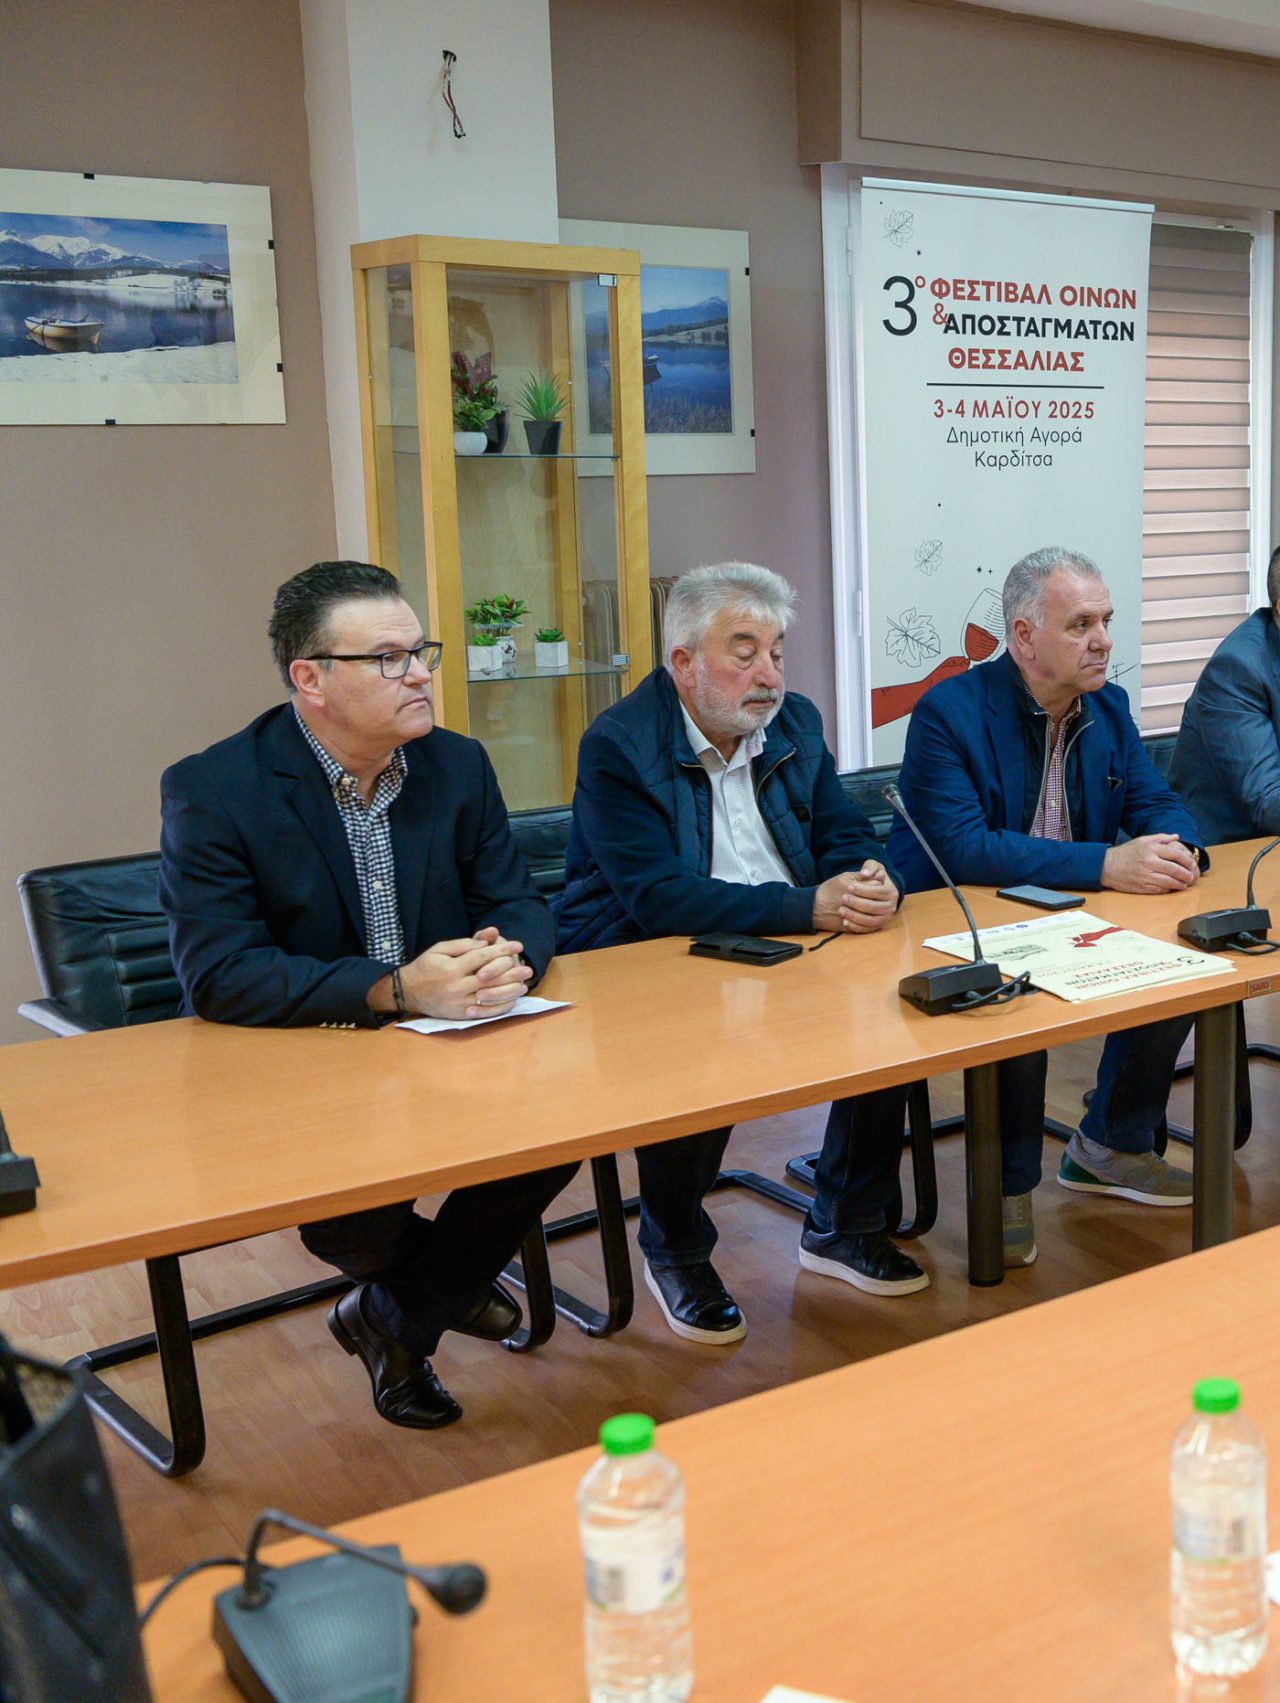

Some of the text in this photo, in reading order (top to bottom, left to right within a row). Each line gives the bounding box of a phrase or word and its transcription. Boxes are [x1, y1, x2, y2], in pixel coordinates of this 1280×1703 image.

[930, 277, 1052, 305] ΦΕΣΤΙΒΑΛ
[1059, 285, 1137, 310] ΟΙΝΩΝ
[943, 313, 1135, 341] ΑΠΟΣΤΑΓΜΑΤΩΝ
[948, 347, 1085, 372] ΘΕΣΣΑΛΙΑΣ
[933, 396, 1095, 419] 3-4 ΜΑΪΟΥ 2025
[946, 426, 1083, 447] Δημοτική Αγορά
[975, 450, 1053, 471] Καρδίτσα
